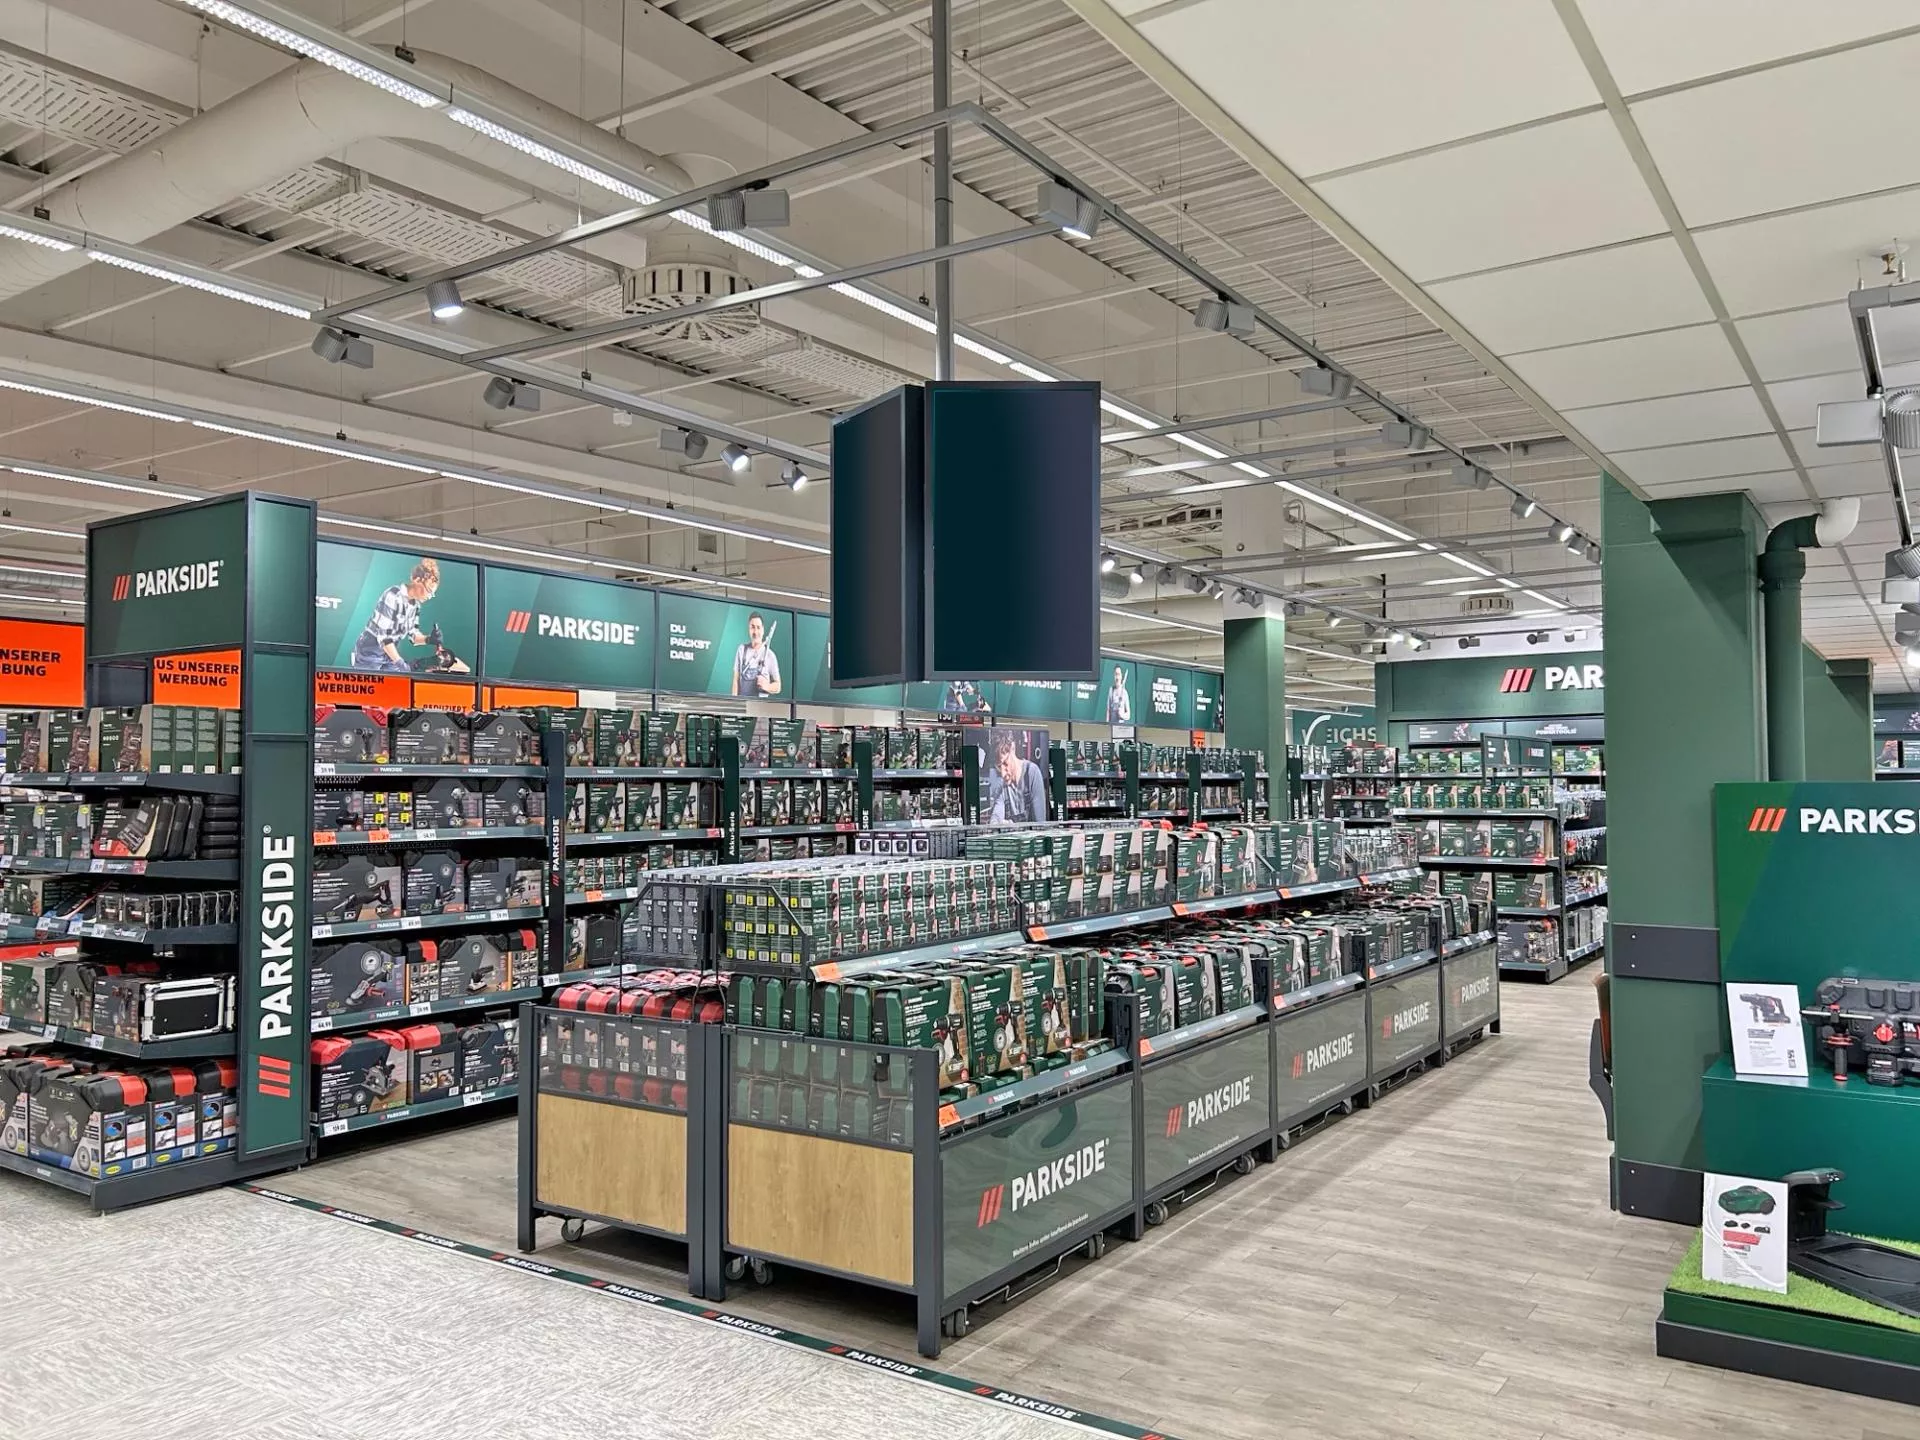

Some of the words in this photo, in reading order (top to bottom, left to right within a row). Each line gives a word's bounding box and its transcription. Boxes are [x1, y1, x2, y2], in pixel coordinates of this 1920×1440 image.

[537, 613, 637, 645] PARKSIDE
[670, 623, 686, 634] DU
[670, 636, 711, 650] PACKST
[0, 663, 47, 677] BUNG
[153, 659, 173, 671] US
[178, 661, 239, 675] UNSERER
[159, 672, 228, 687] WERBUNG
[334, 671, 384, 684] UNSERER
[1545, 666, 1605, 692] PAR
[318, 682, 375, 694] WERBUNG
[1800, 808, 1920, 834] PARKS
[552, 818, 560, 872] PARKSIDE
[1394, 1002, 1430, 1034] PARKSIDE
[1306, 1035, 1353, 1073] PARKSIDE
[1187, 1079, 1251, 1128] PARKSIDE
[1011, 1139, 1106, 1212] PARKSIDE
[715, 1314, 781, 1337] PARKSIDE
[845, 1350, 918, 1376] PARKSIDE
[993, 1391, 1078, 1420] PARKSIDE
